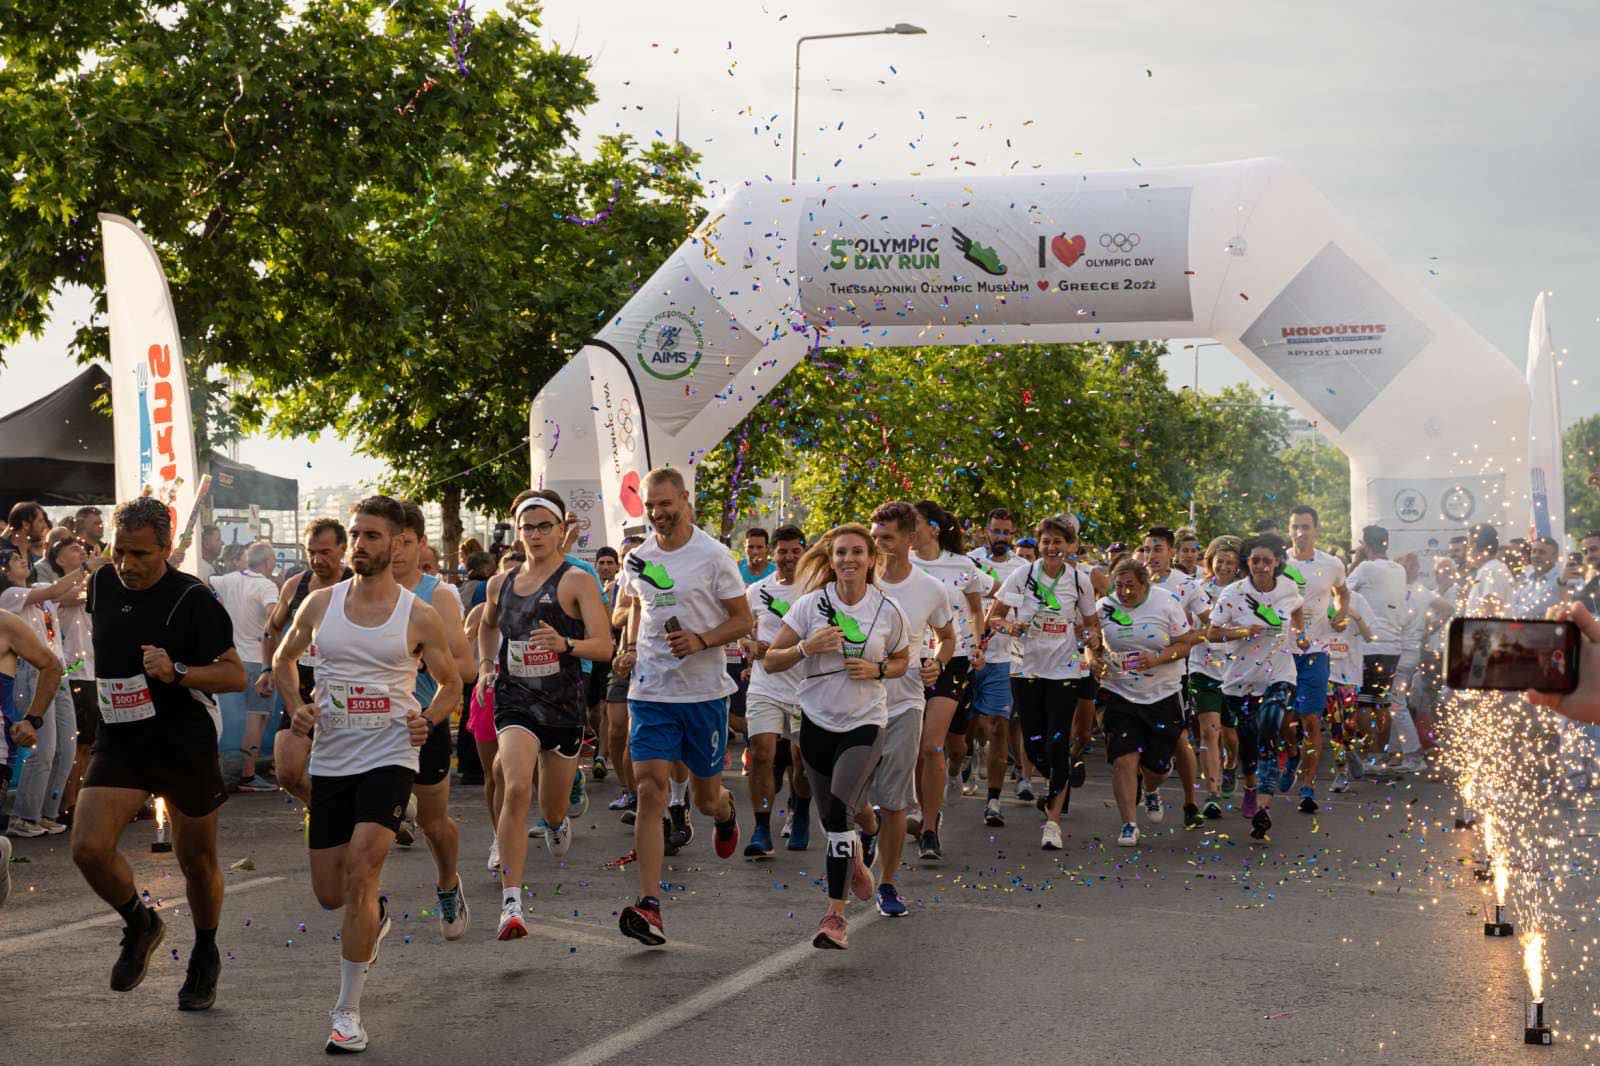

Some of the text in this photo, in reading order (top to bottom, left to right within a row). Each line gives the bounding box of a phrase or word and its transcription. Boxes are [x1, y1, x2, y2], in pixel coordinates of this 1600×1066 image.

[855, 238, 939, 253] OLYMPIC
[1039, 236, 1046, 268] I
[855, 255, 939, 270] DAY RUN
[1086, 258, 1154, 268] OLYMPIC DAY
[1058, 278, 1156, 291] GREECE 2022
[652, 351, 687, 363] AIMS
[115, 692, 144, 705] 50074
[352, 700, 384, 709] 50310
[711, 730, 719, 757] 9
